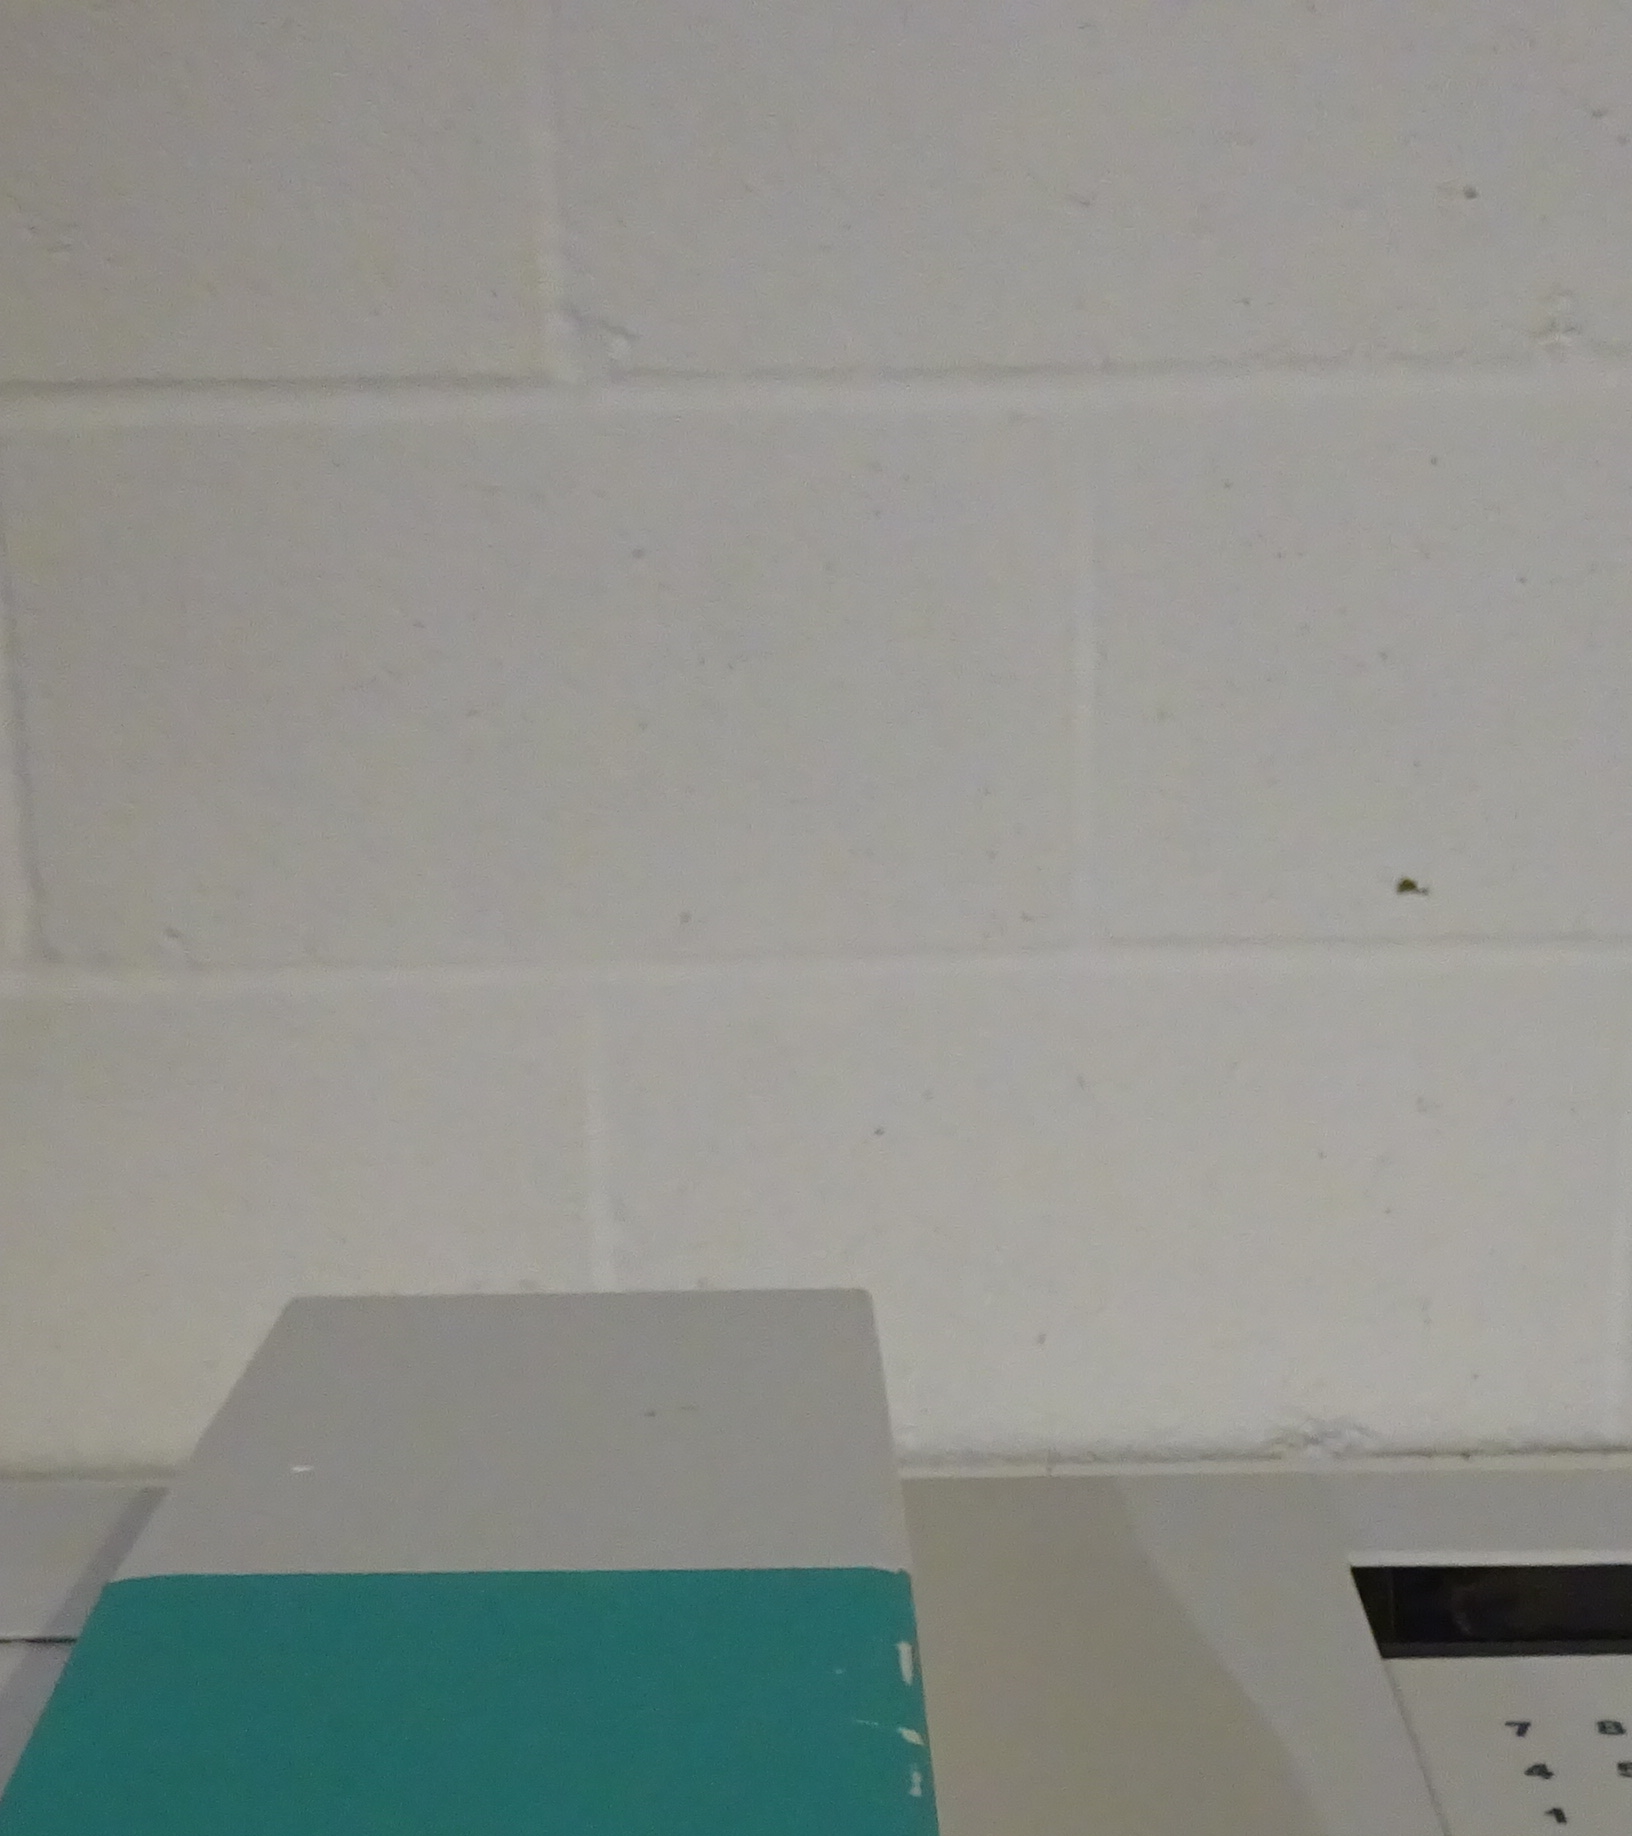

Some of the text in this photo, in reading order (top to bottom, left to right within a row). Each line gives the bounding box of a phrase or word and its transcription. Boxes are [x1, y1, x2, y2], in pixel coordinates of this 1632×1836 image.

[1505, 1720, 1531, 1738] 7
[1596, 1719, 1626, 1736] 8
[1524, 1762, 1554, 1780] 4
[1544, 1806, 1567, 1825] 1
